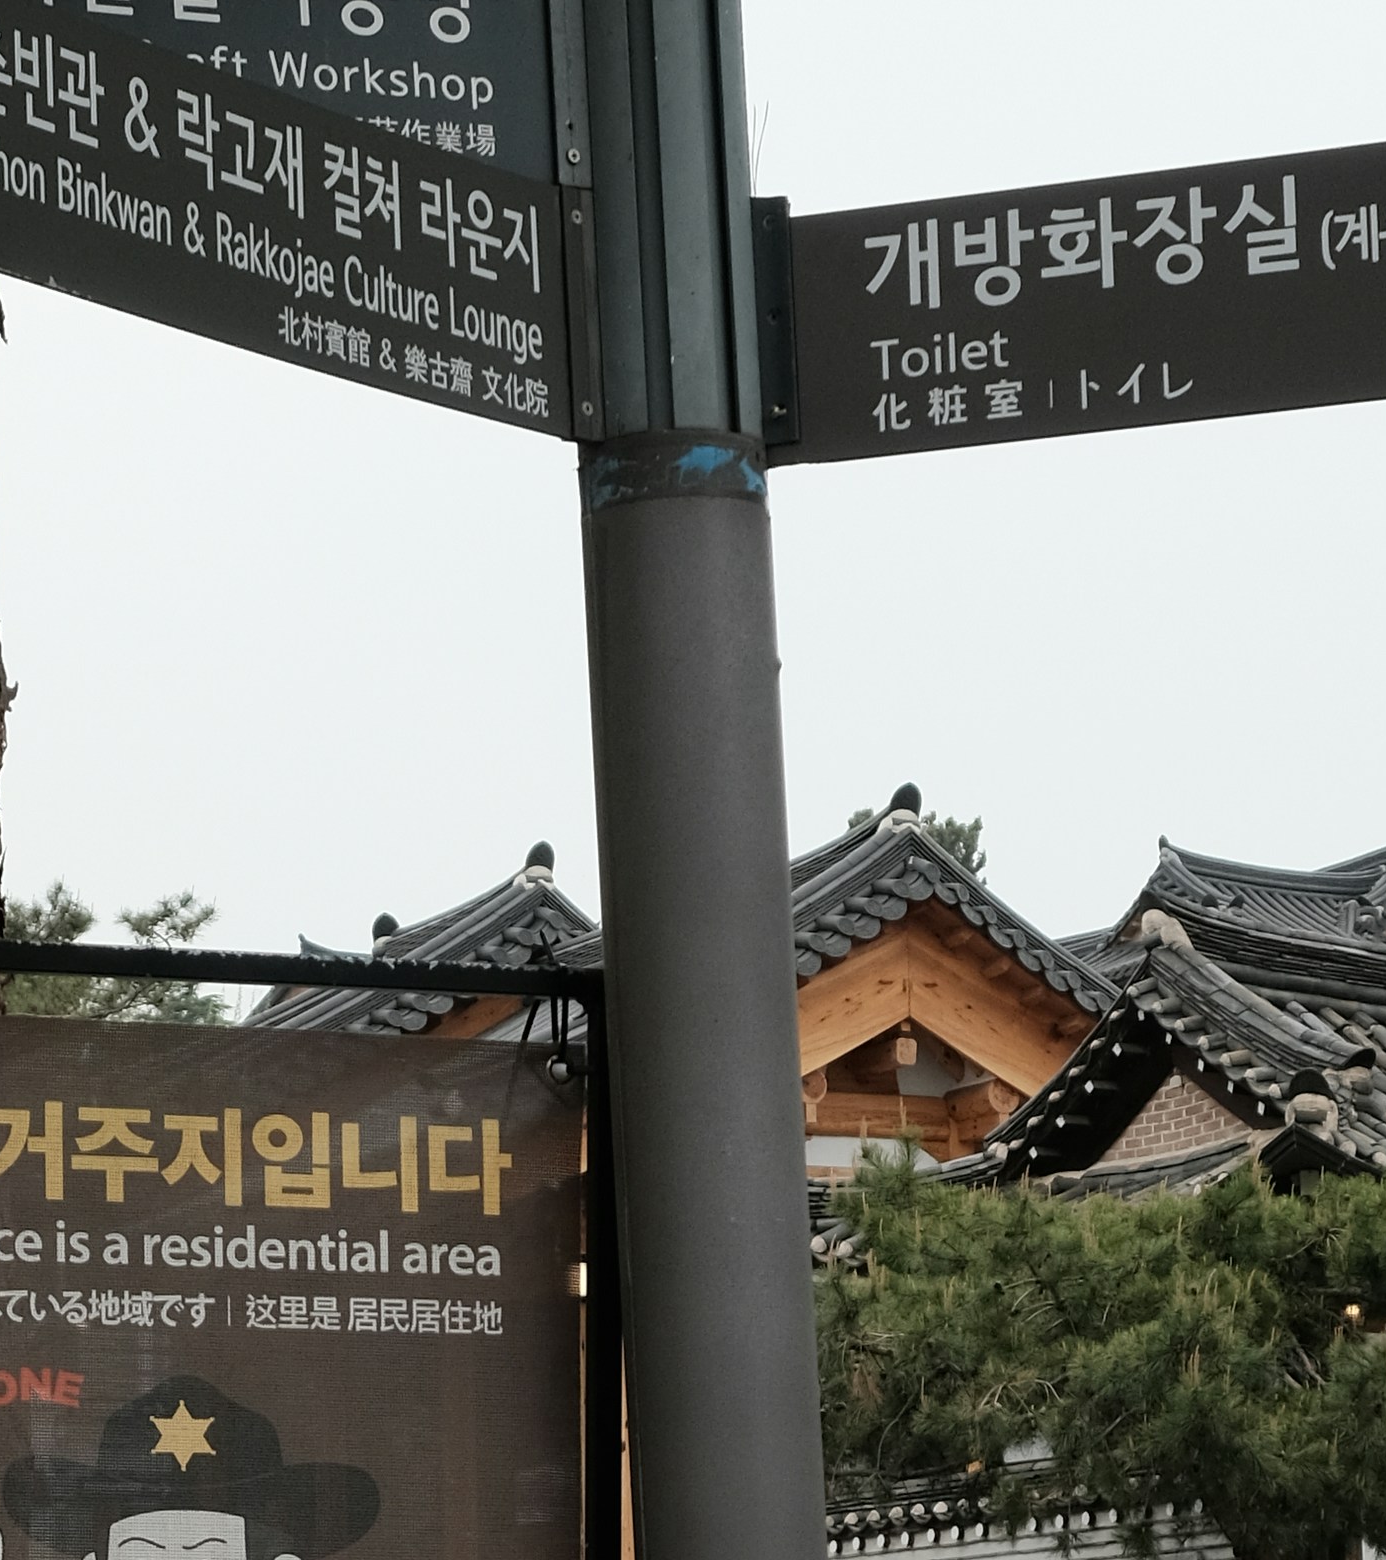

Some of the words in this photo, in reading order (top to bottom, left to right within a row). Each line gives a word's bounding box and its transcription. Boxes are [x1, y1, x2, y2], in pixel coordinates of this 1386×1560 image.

[269, 50, 493, 110] Workshop
[125, 77, 160, 158] &
[177, 89, 304, 219] 락고재
[324, 142, 401, 250] 컬쳐
[420, 178, 540, 293] 라운지
[58, 157, 171, 245] Binkwan
[184, 202, 206, 257] &
[217, 212, 334, 298] Rakkojae
[345, 256, 439, 330] Culture
[450, 287, 542, 364] Lounge
[865, 175, 1299, 309] 개방화장실
[379, 338, 396, 372] &
[482, 366, 548, 417] 文化院
[870, 331, 1008, 380] Toilet
[57, 1220, 90, 1263] is
[103, 1233, 128, 1264] a
[144, 1225, 388, 1272] residential
[403, 1243, 500, 1276] area
